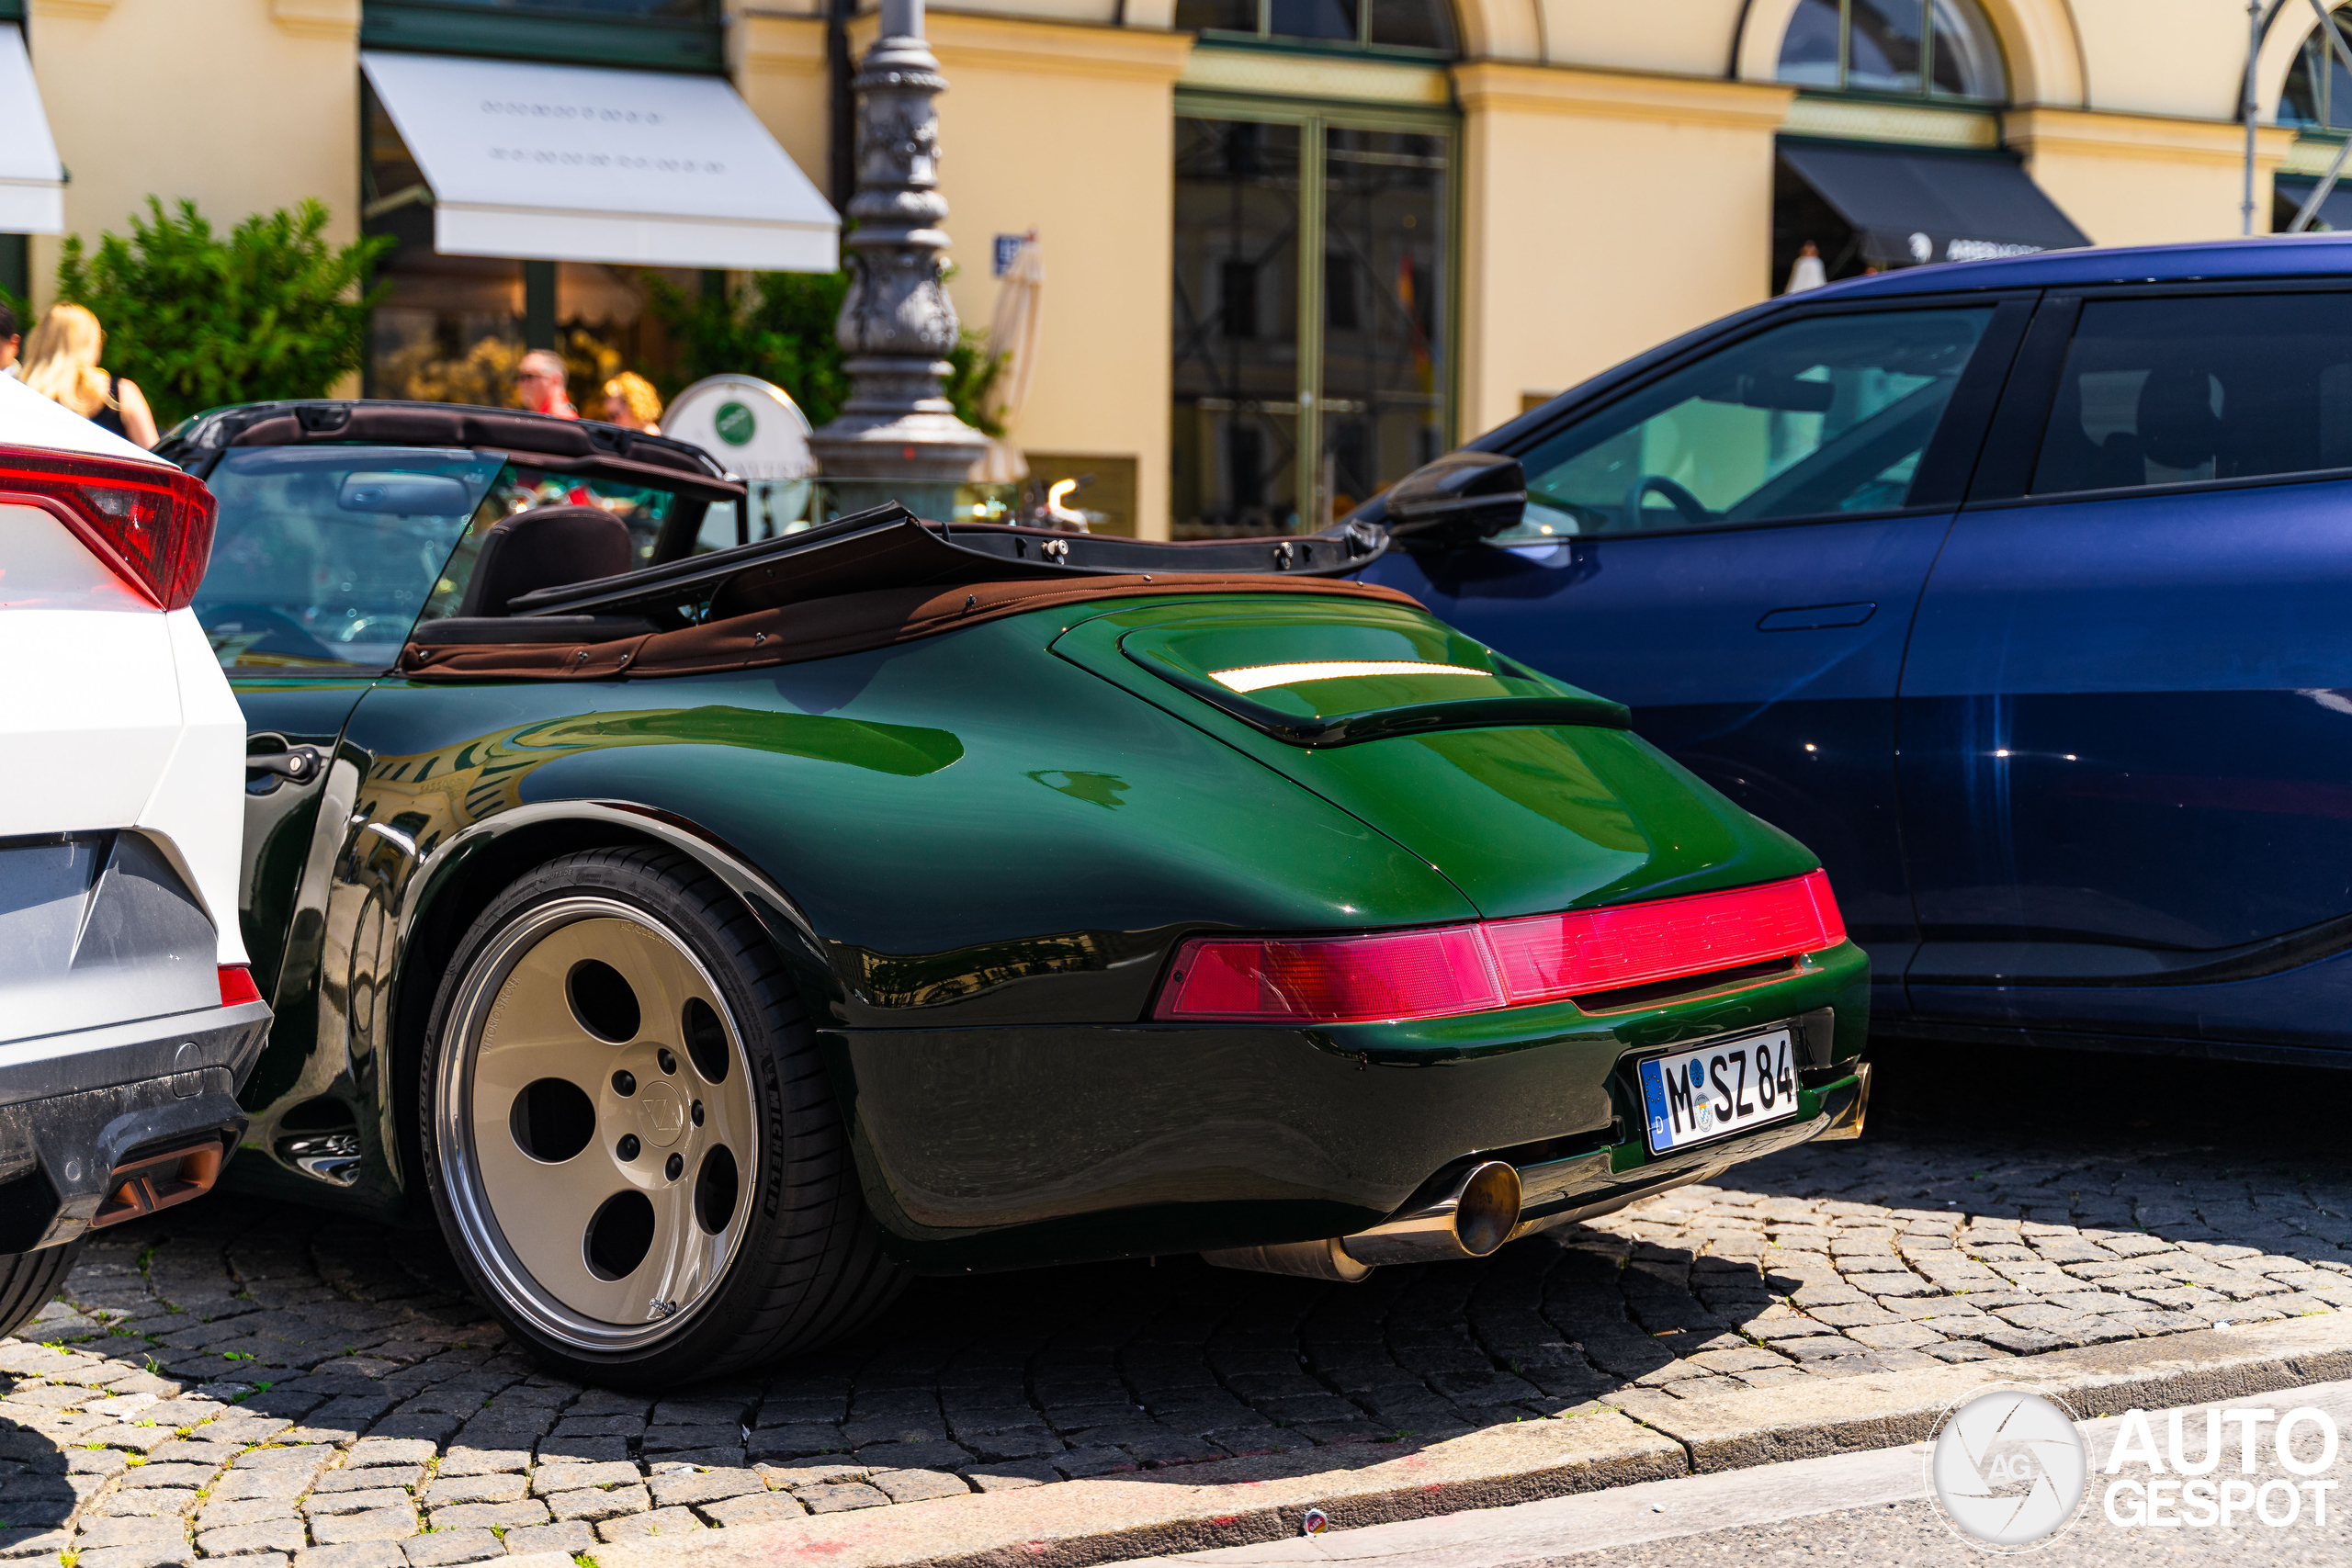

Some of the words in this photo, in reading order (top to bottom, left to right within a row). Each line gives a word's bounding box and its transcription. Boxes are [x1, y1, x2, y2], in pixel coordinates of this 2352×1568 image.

[546, 869, 574, 881] OUTSIDE
[481, 1010, 503, 1055] VITTORIO
[1665, 1064, 1696, 1134] M
[1710, 1050, 1754, 1122] SZ
[1756, 1040, 1793, 1111] 84
[1655, 1115, 1664, 1134] D
[766, 1089, 782, 1214] MICHELIN
[758, 1226, 771, 1256] PILOT
[741, 1258, 760, 1292] SPORT
